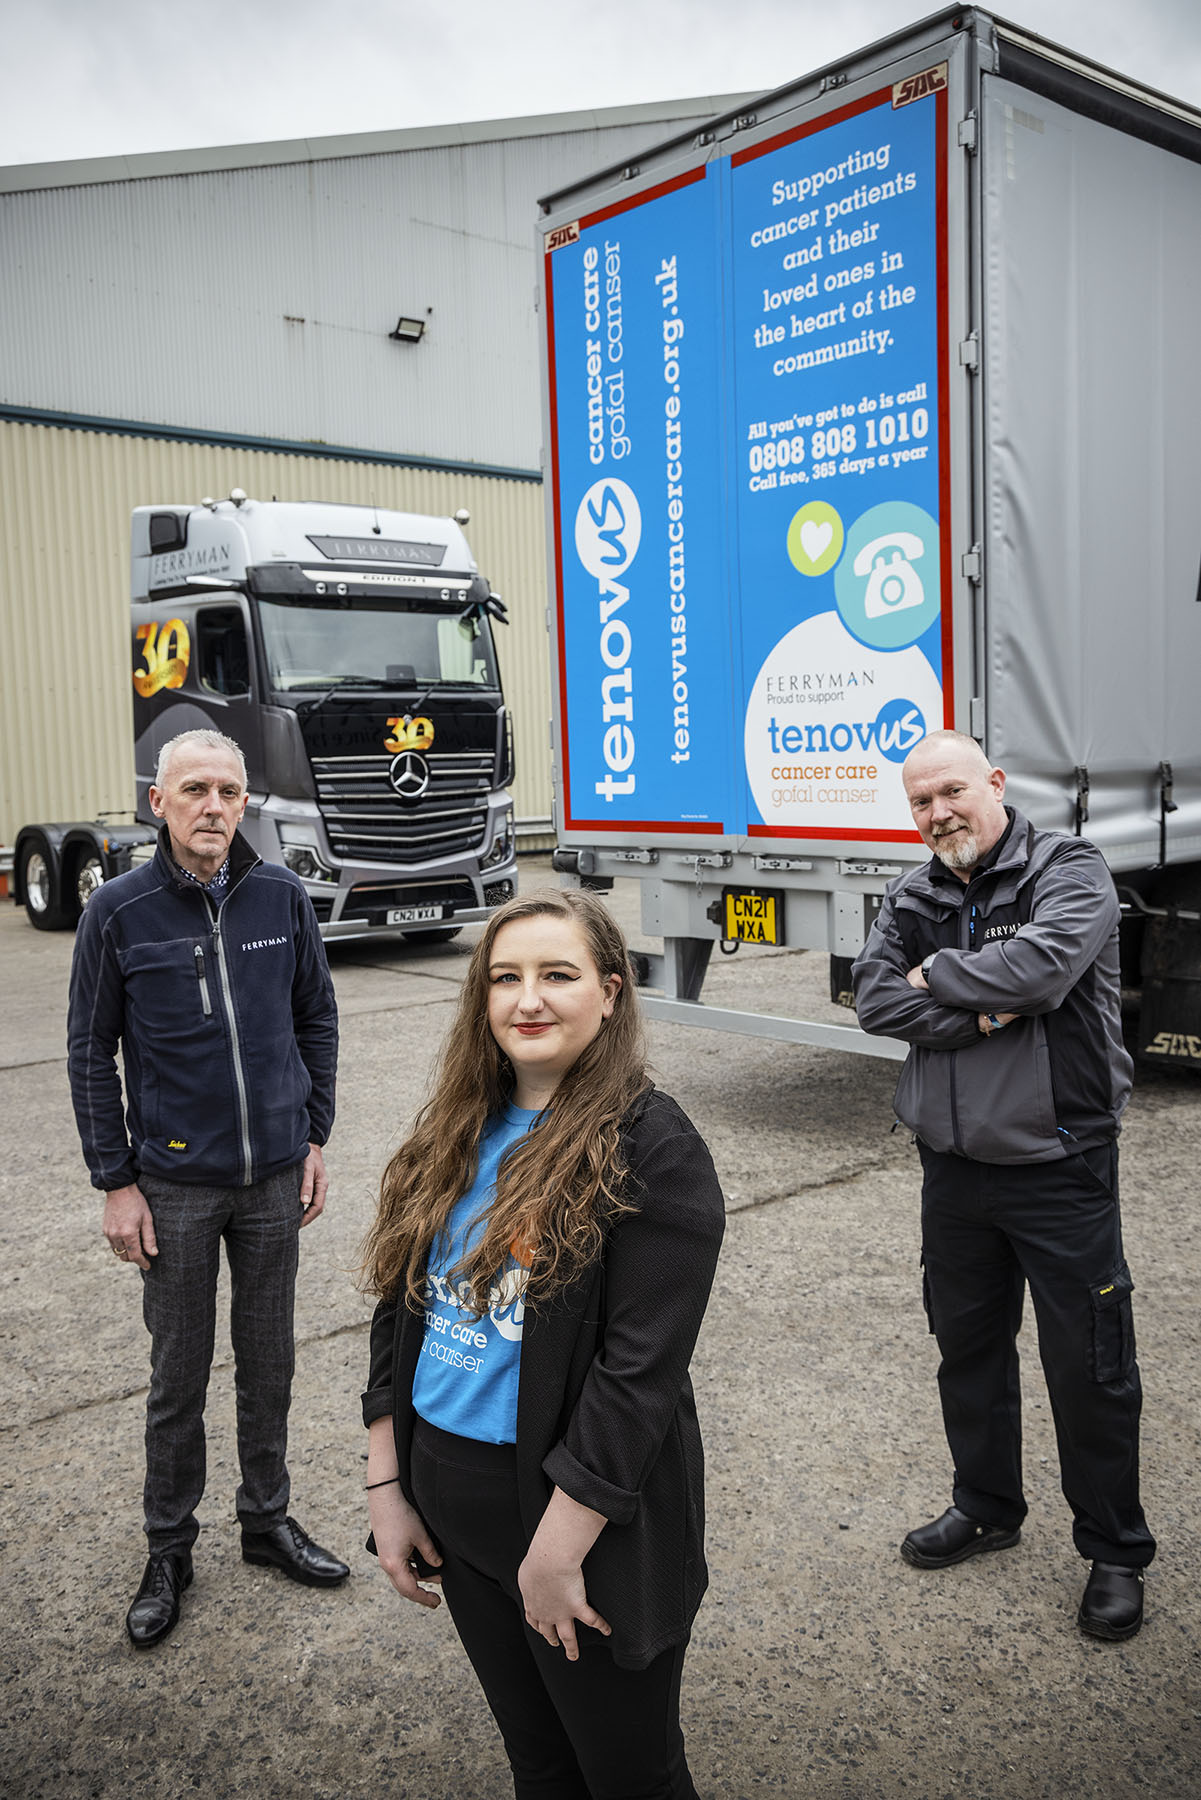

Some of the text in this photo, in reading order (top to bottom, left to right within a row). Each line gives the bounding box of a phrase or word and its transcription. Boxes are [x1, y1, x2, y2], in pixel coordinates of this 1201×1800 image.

[895, 69, 946, 105] SDC
[772, 144, 891, 206] Supporting
[750, 172, 917, 248] cancer patients
[547, 225, 578, 249] SDC
[783, 220, 880, 271] and their
[763, 249, 904, 312] loved ones in
[753, 284, 916, 348] the heart of the
[583, 247, 605, 465] cancer care
[604, 240, 632, 460] gofal canser
[773, 326, 894, 376] community.
[748, 383, 928, 440] All you've got to do is call
[749, 408, 929, 474] 0808 808 1010
[749, 446, 929, 492] Call free, 365 days a year
[655, 255, 690, 764] tenovuscancercare.org.uk
[154, 543, 231, 575] FERRYMAN
[333, 542, 433, 560] FERRYMAN
[132, 618, 191, 697] 30
[587, 484, 636, 802] tenovus
[766, 670, 875, 692] FERRYMAN
[767, 691, 845, 705] Proud to support
[383, 716, 435, 754] 30
[767, 708, 925, 754] tenovus
[771, 765, 878, 780] cancer care
[771, 785, 879, 808] gofal canser
[393, 908, 435, 922] CN21 WXA
[734, 898, 768, 919] CN21
[736, 919, 766, 940] WXA
[242, 936, 288, 951] FERRYMAN
[450, 1323, 488, 1349] care
[429, 1341, 485, 1374] canser
